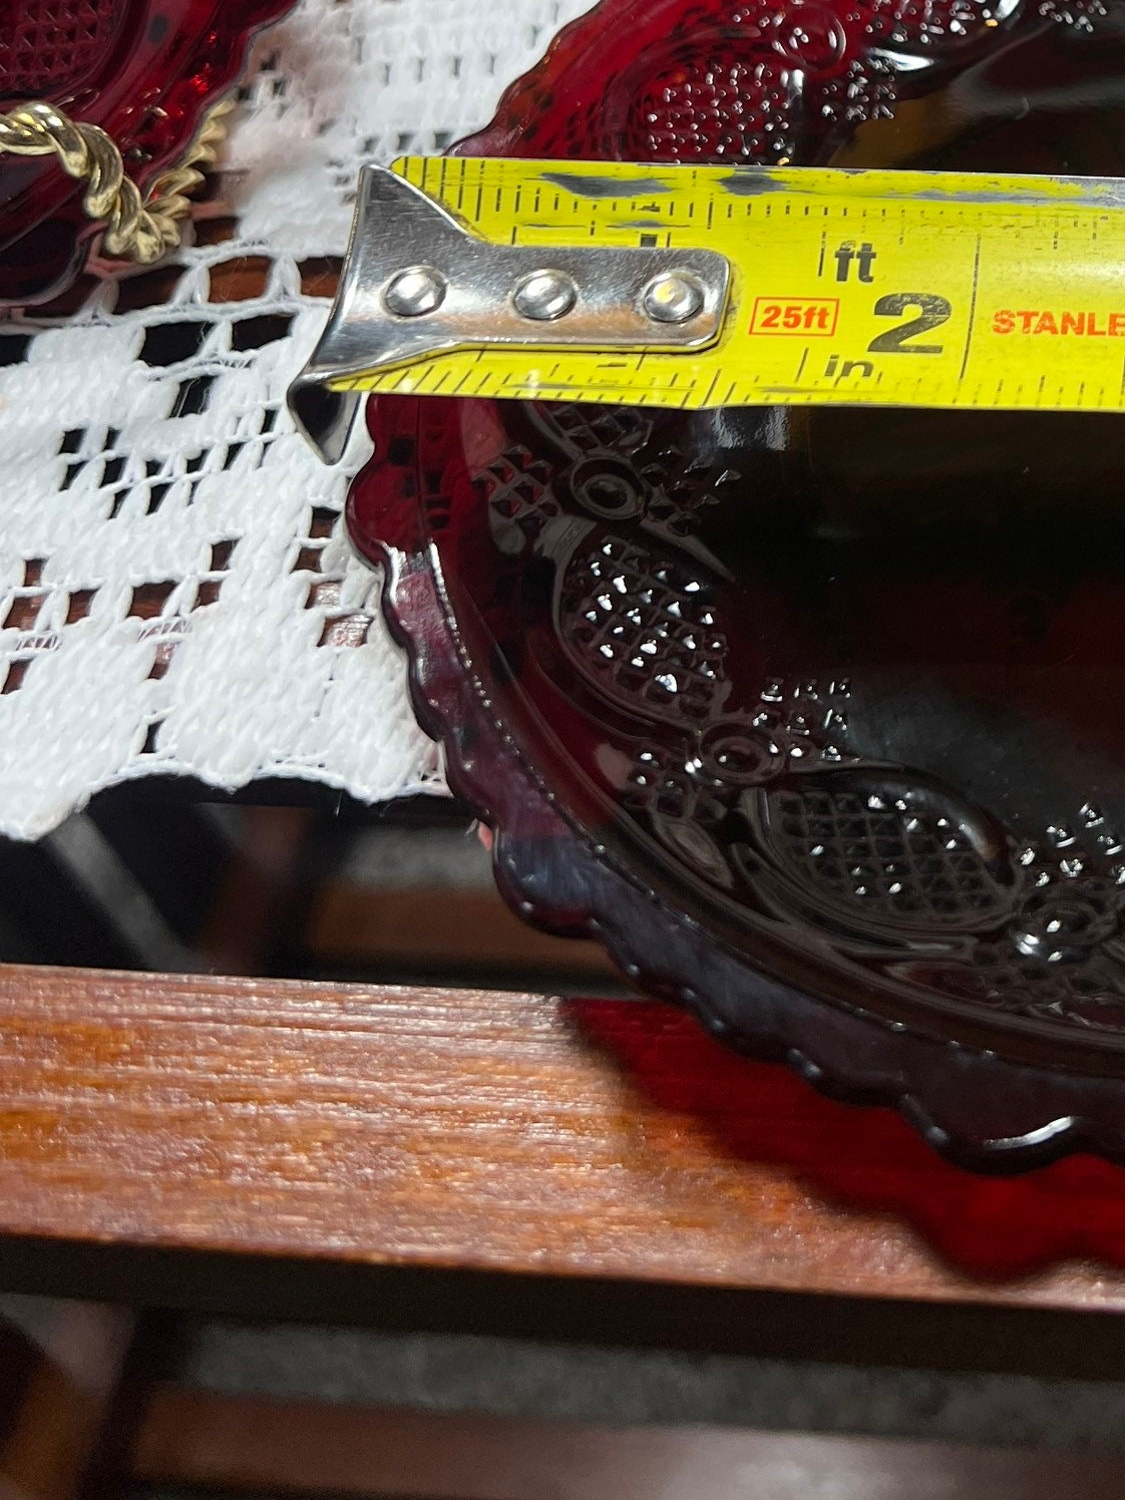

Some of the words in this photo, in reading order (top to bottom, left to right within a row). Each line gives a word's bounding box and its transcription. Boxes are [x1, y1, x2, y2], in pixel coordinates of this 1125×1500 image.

[835, 240, 876, 283] ft
[760, 305, 829, 329] 25ft
[867, 292, 951, 354] 2
[824, 354, 875, 378] in
